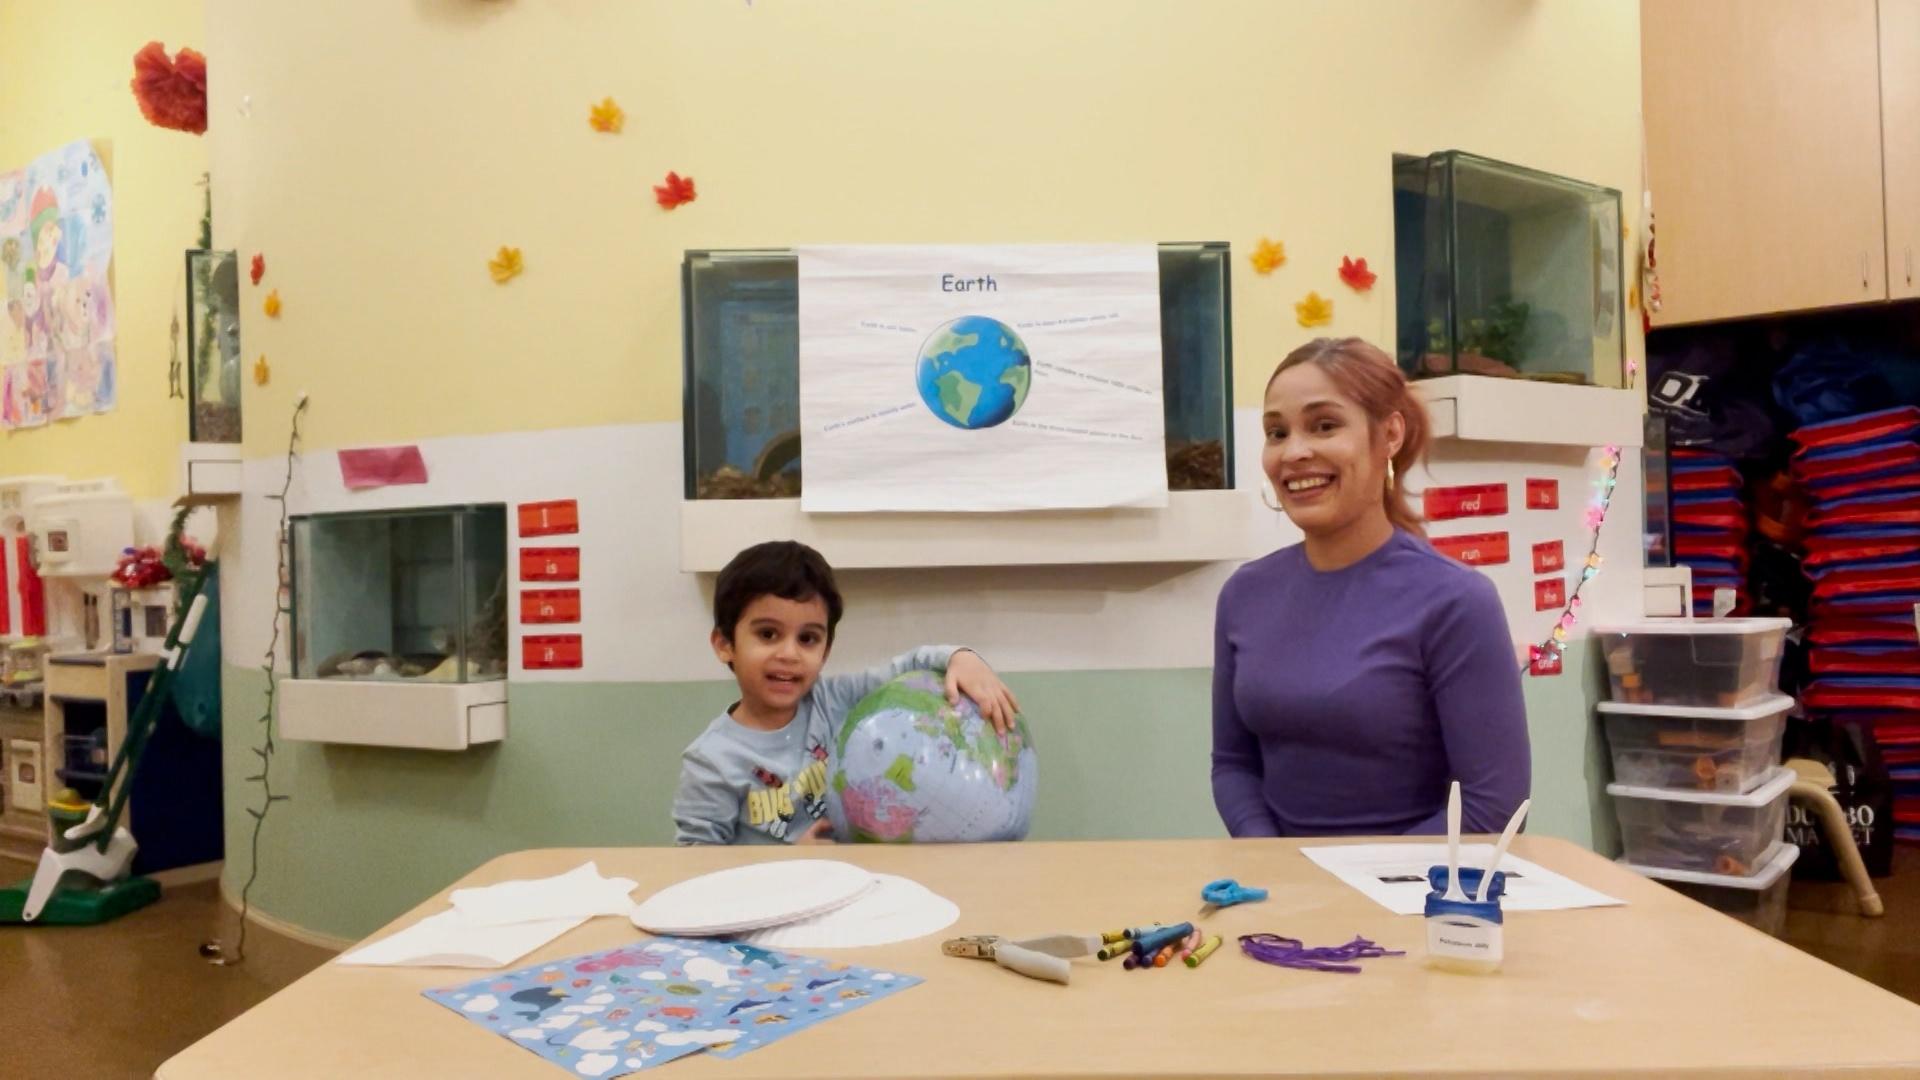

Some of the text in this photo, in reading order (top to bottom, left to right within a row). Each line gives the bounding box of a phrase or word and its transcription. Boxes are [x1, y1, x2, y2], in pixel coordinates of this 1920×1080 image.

[942, 274, 997, 292] Earth
[1461, 494, 1480, 510] red
[1462, 549, 1480, 560] run
[545, 558, 558, 575] is
[540, 599, 555, 616] in
[749, 784, 794, 824] BUG
